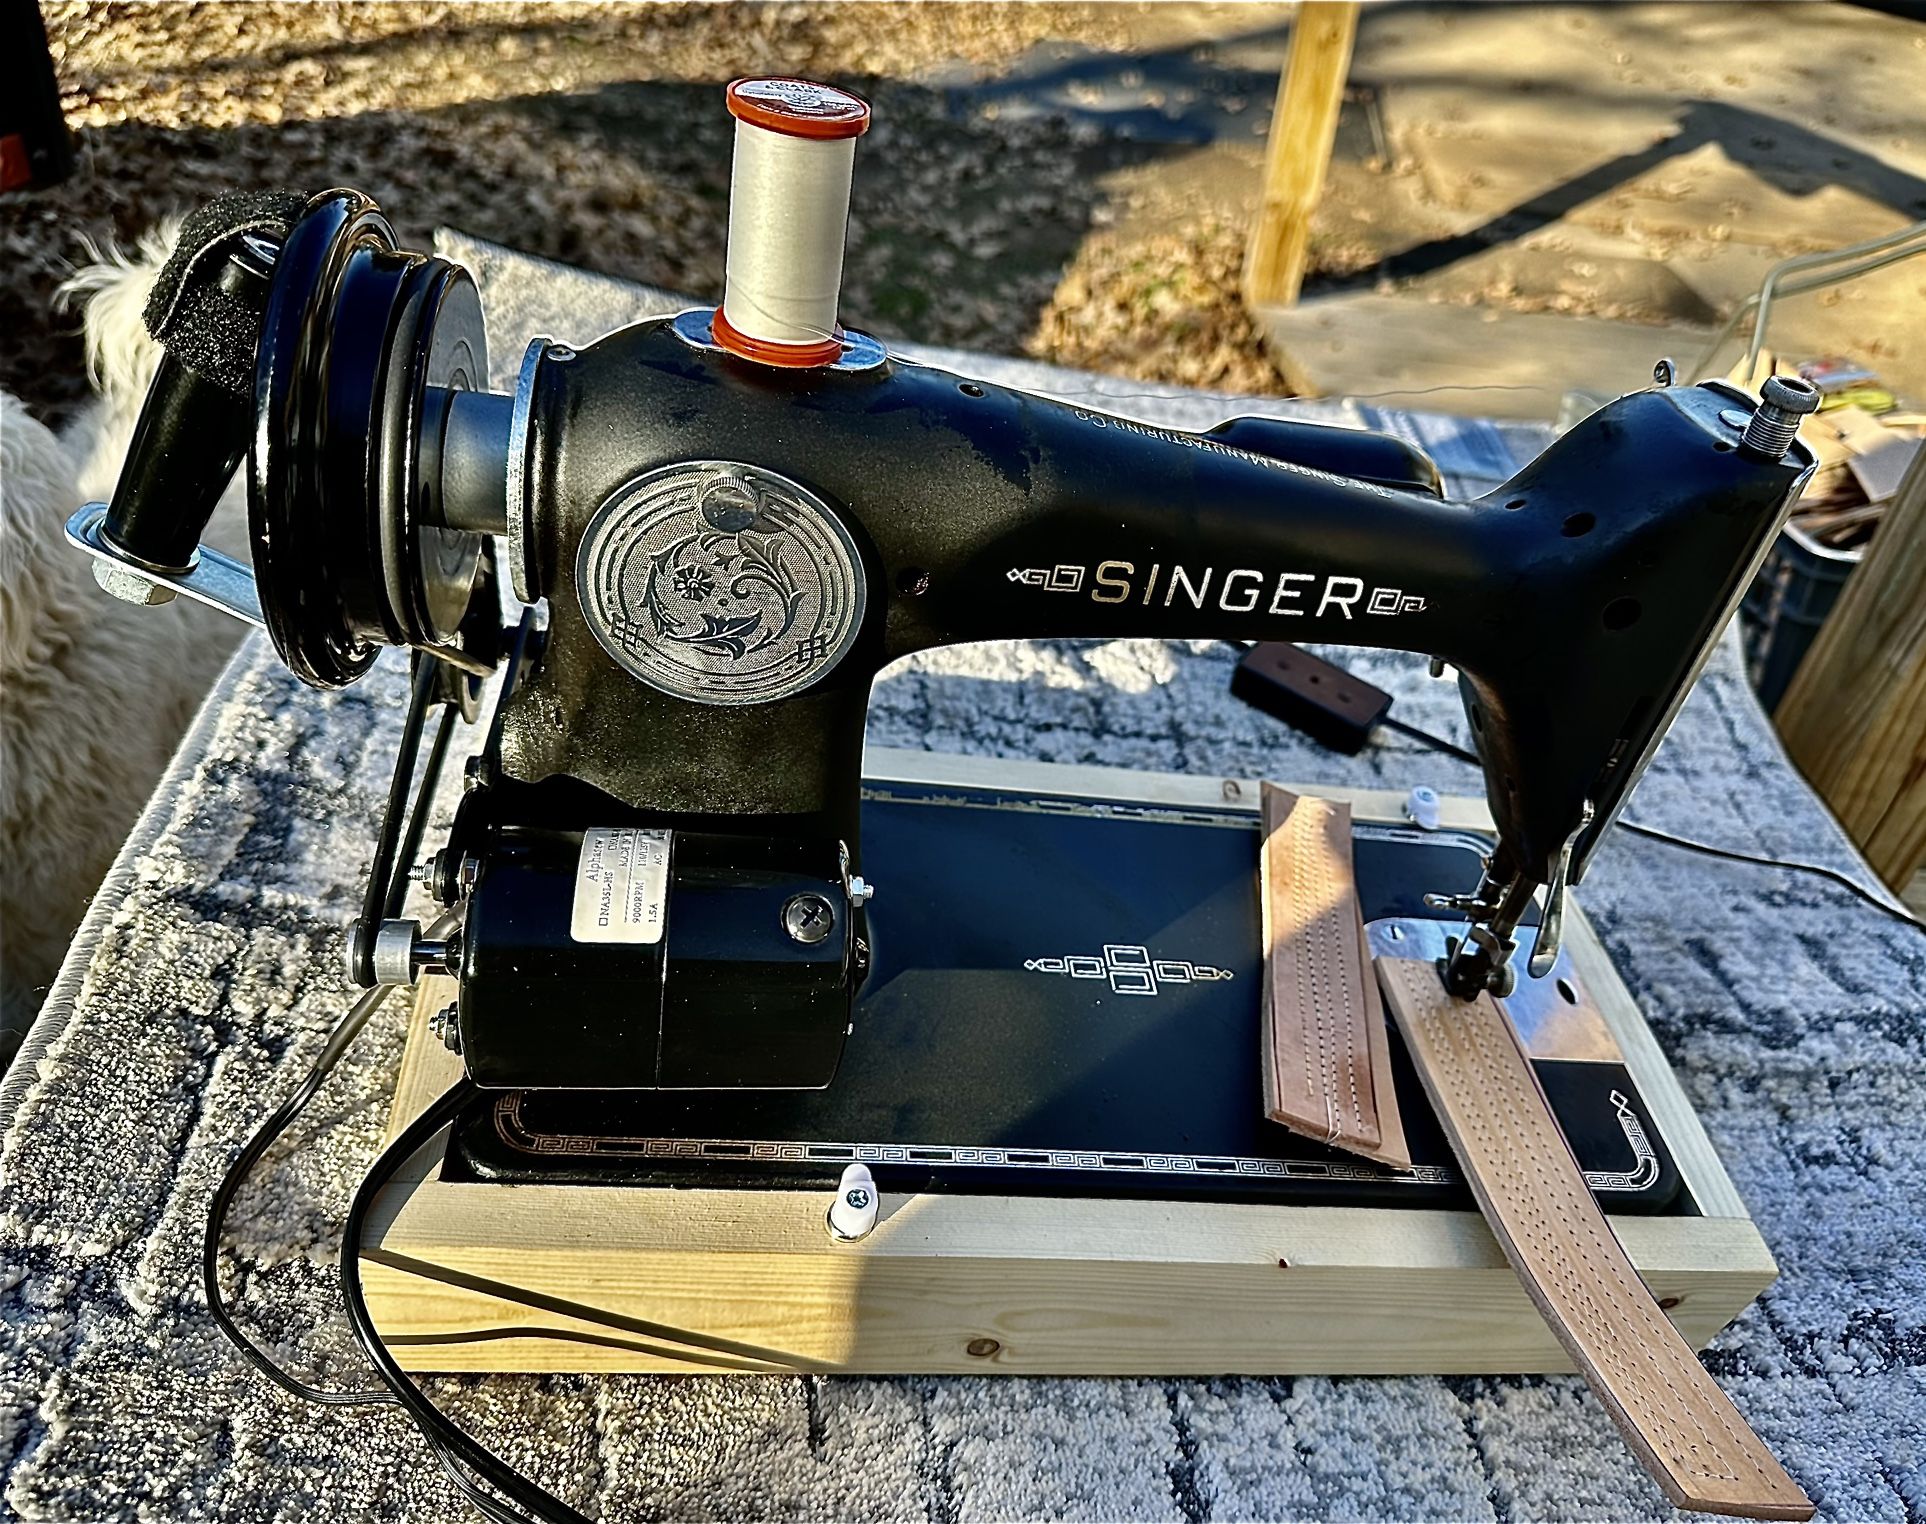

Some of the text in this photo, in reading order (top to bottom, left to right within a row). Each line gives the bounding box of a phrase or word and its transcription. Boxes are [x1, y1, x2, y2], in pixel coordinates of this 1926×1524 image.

[1091, 559, 1366, 620] SINGER
[632, 882, 644, 923] 9000RPM
[648, 853, 664, 923] 1.5A AC
